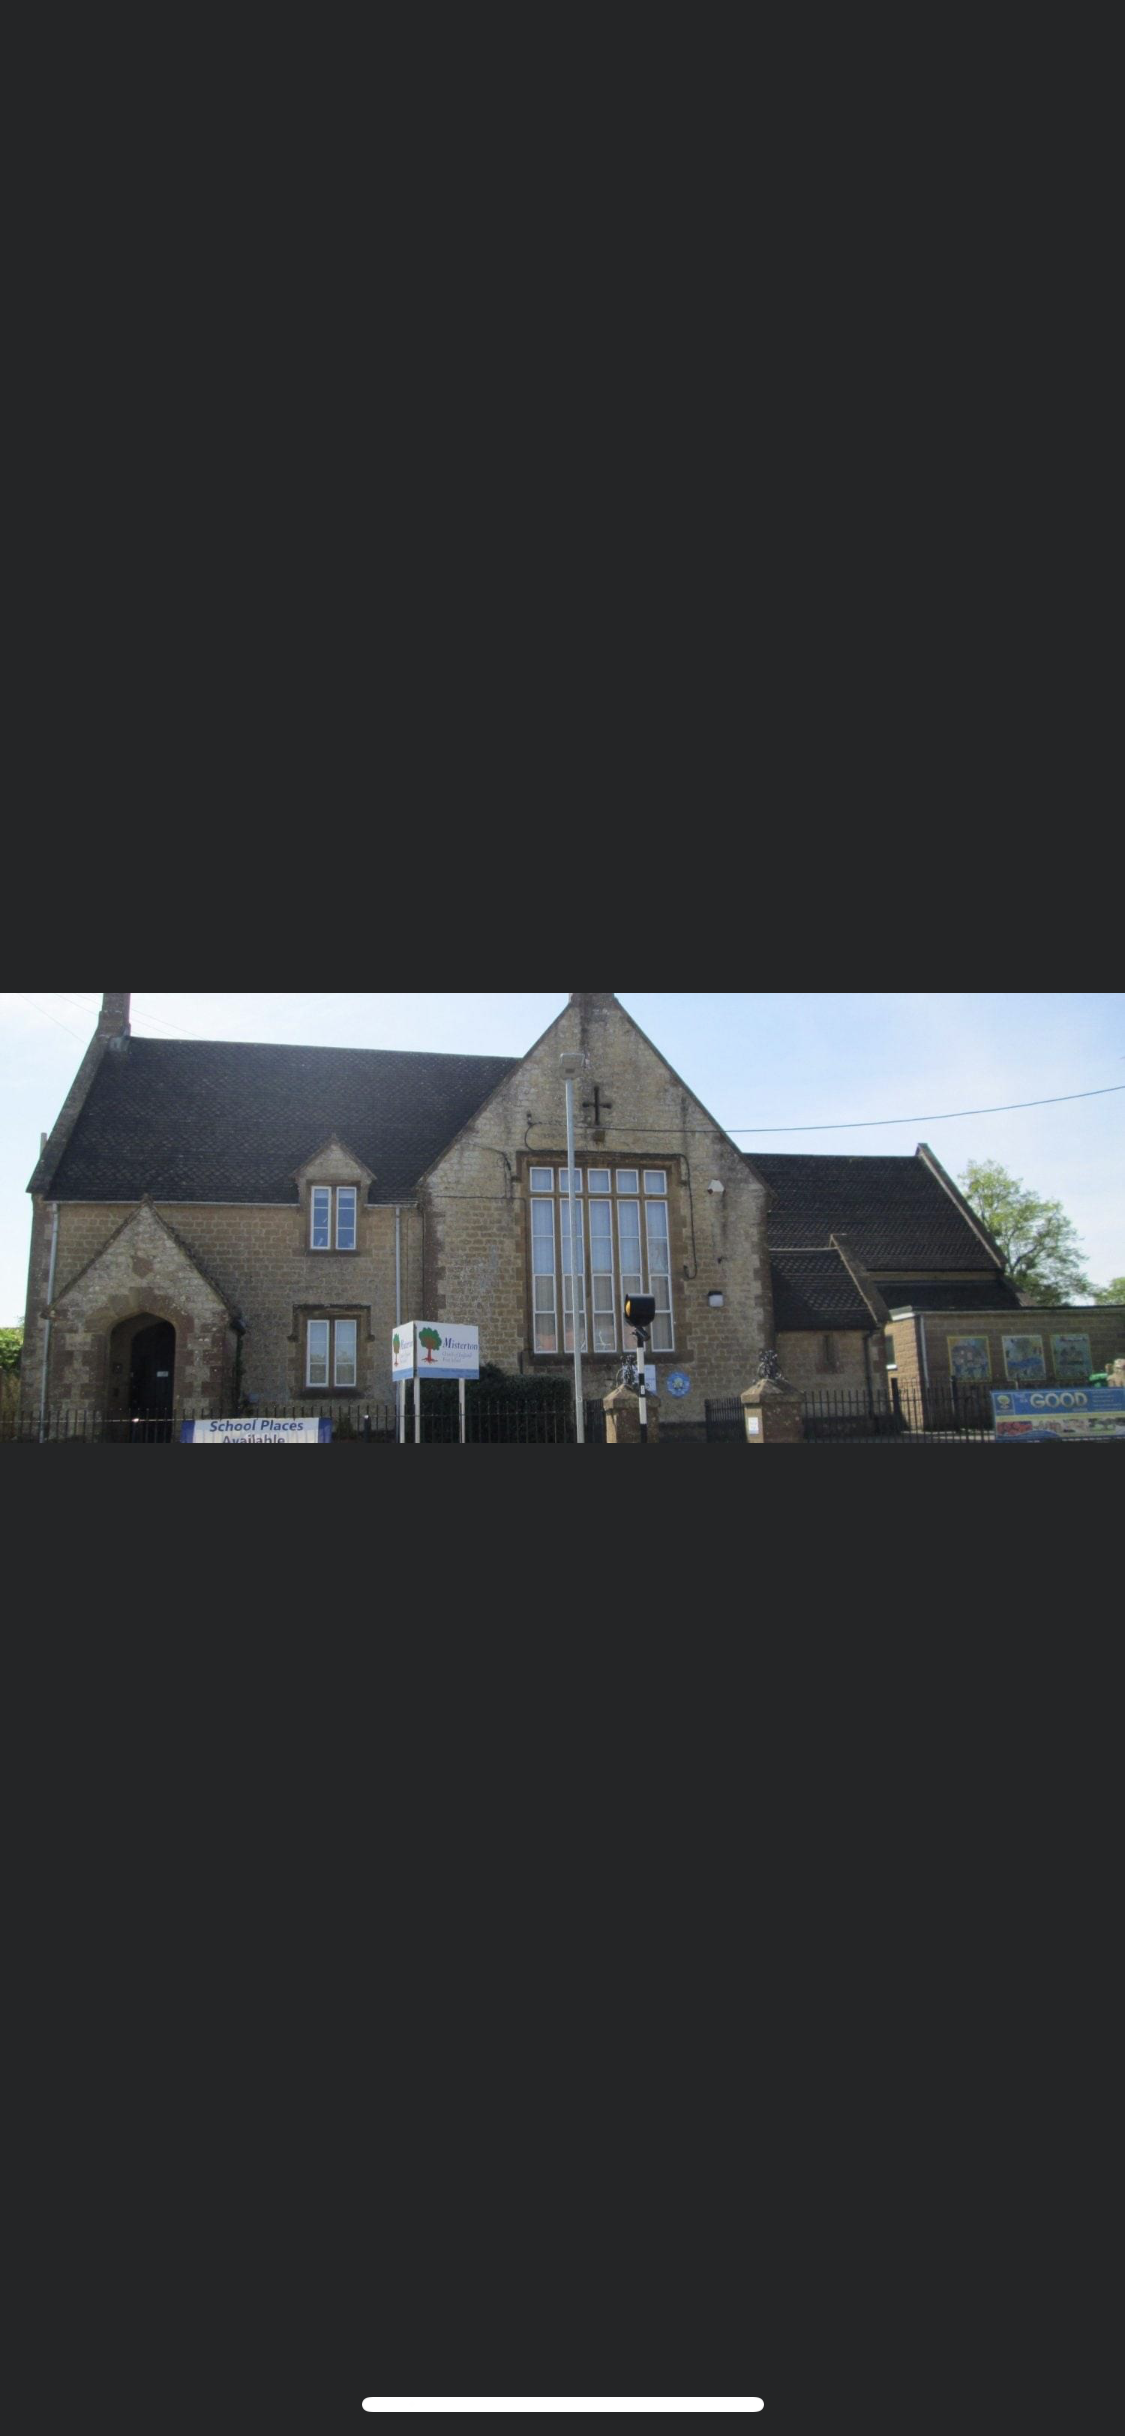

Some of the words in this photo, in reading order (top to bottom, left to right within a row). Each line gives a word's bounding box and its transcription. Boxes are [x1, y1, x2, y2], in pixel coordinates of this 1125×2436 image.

[442, 1337, 478, 1350] Misterton
[1030, 1392, 1088, 1408] GOOD
[209, 1420, 257, 1432] School
[260, 1420, 304, 1431] Places
[222, 1434, 286, 1444] Available
